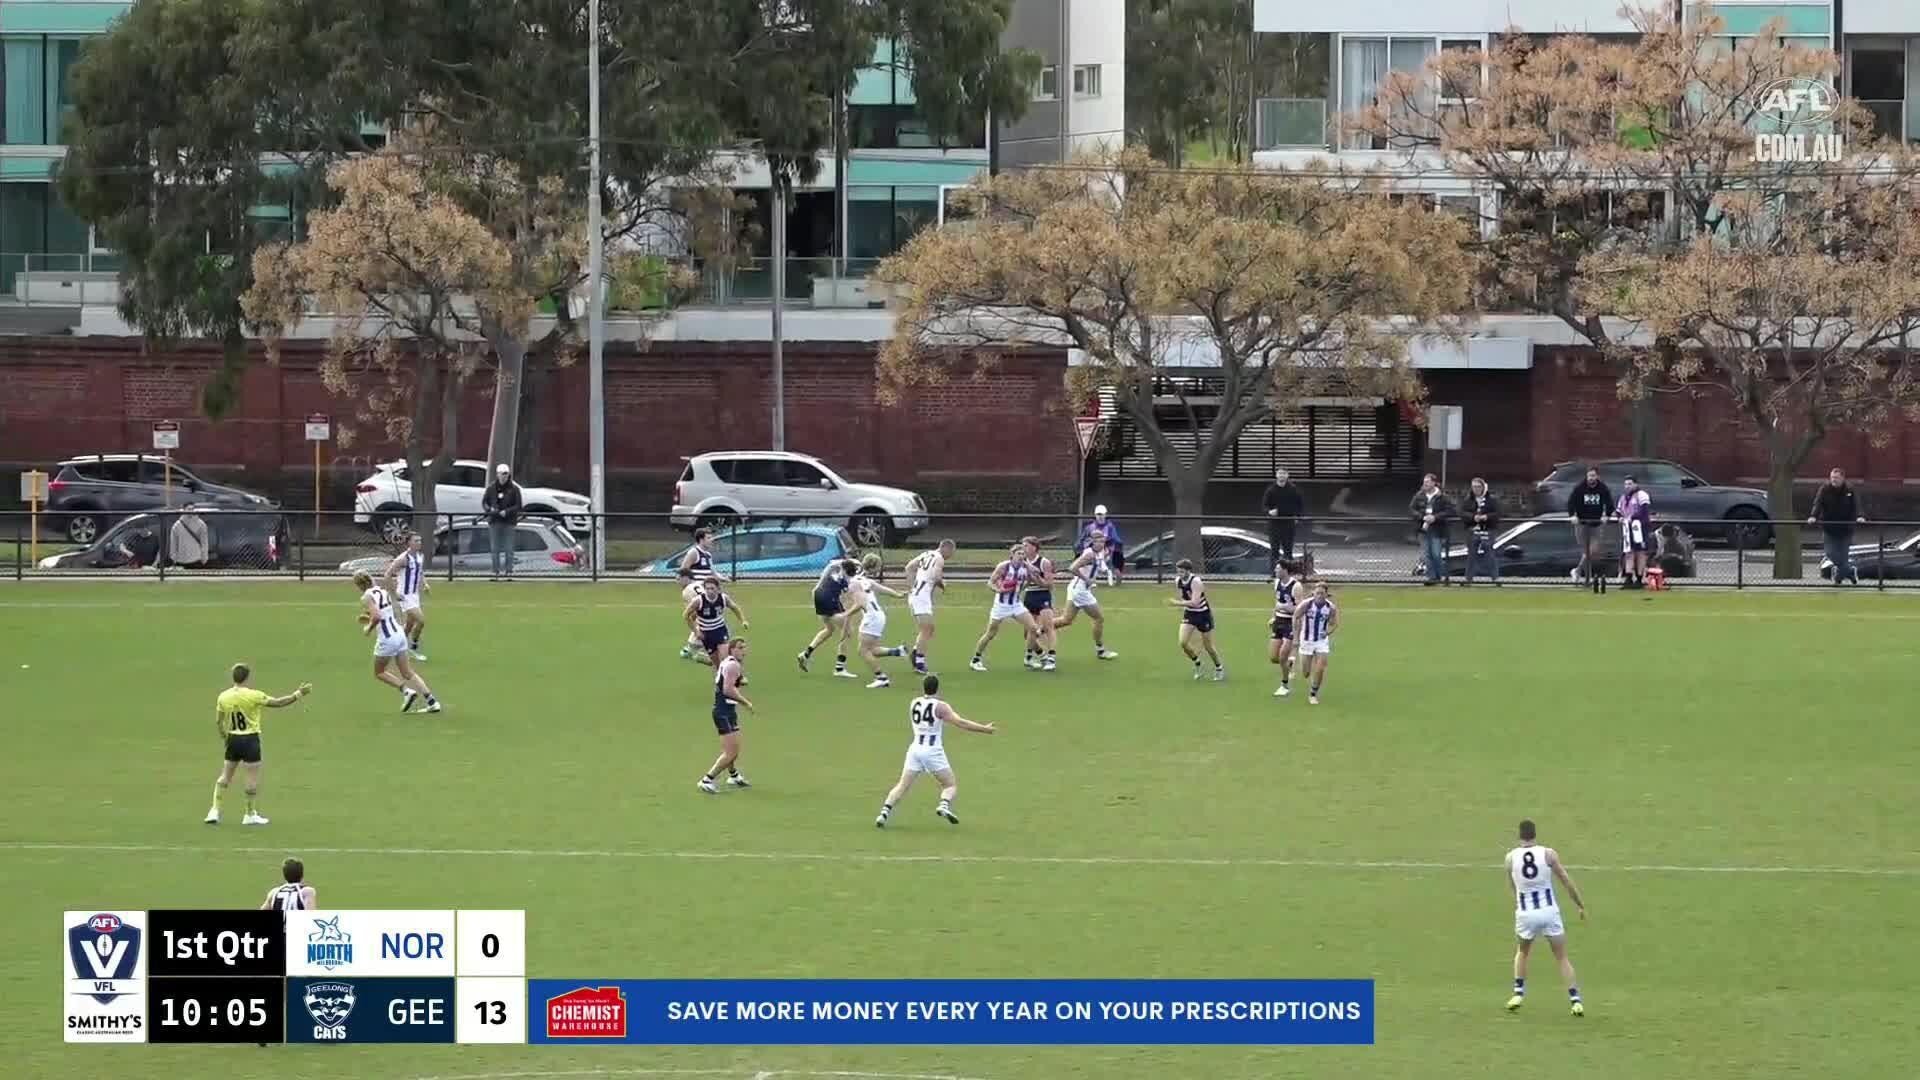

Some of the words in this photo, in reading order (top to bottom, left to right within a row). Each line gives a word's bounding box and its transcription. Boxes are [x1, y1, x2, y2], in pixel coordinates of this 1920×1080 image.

[231, 711, 247, 731] 18
[912, 701, 935, 727] 64
[1522, 851, 1538, 879] 8
